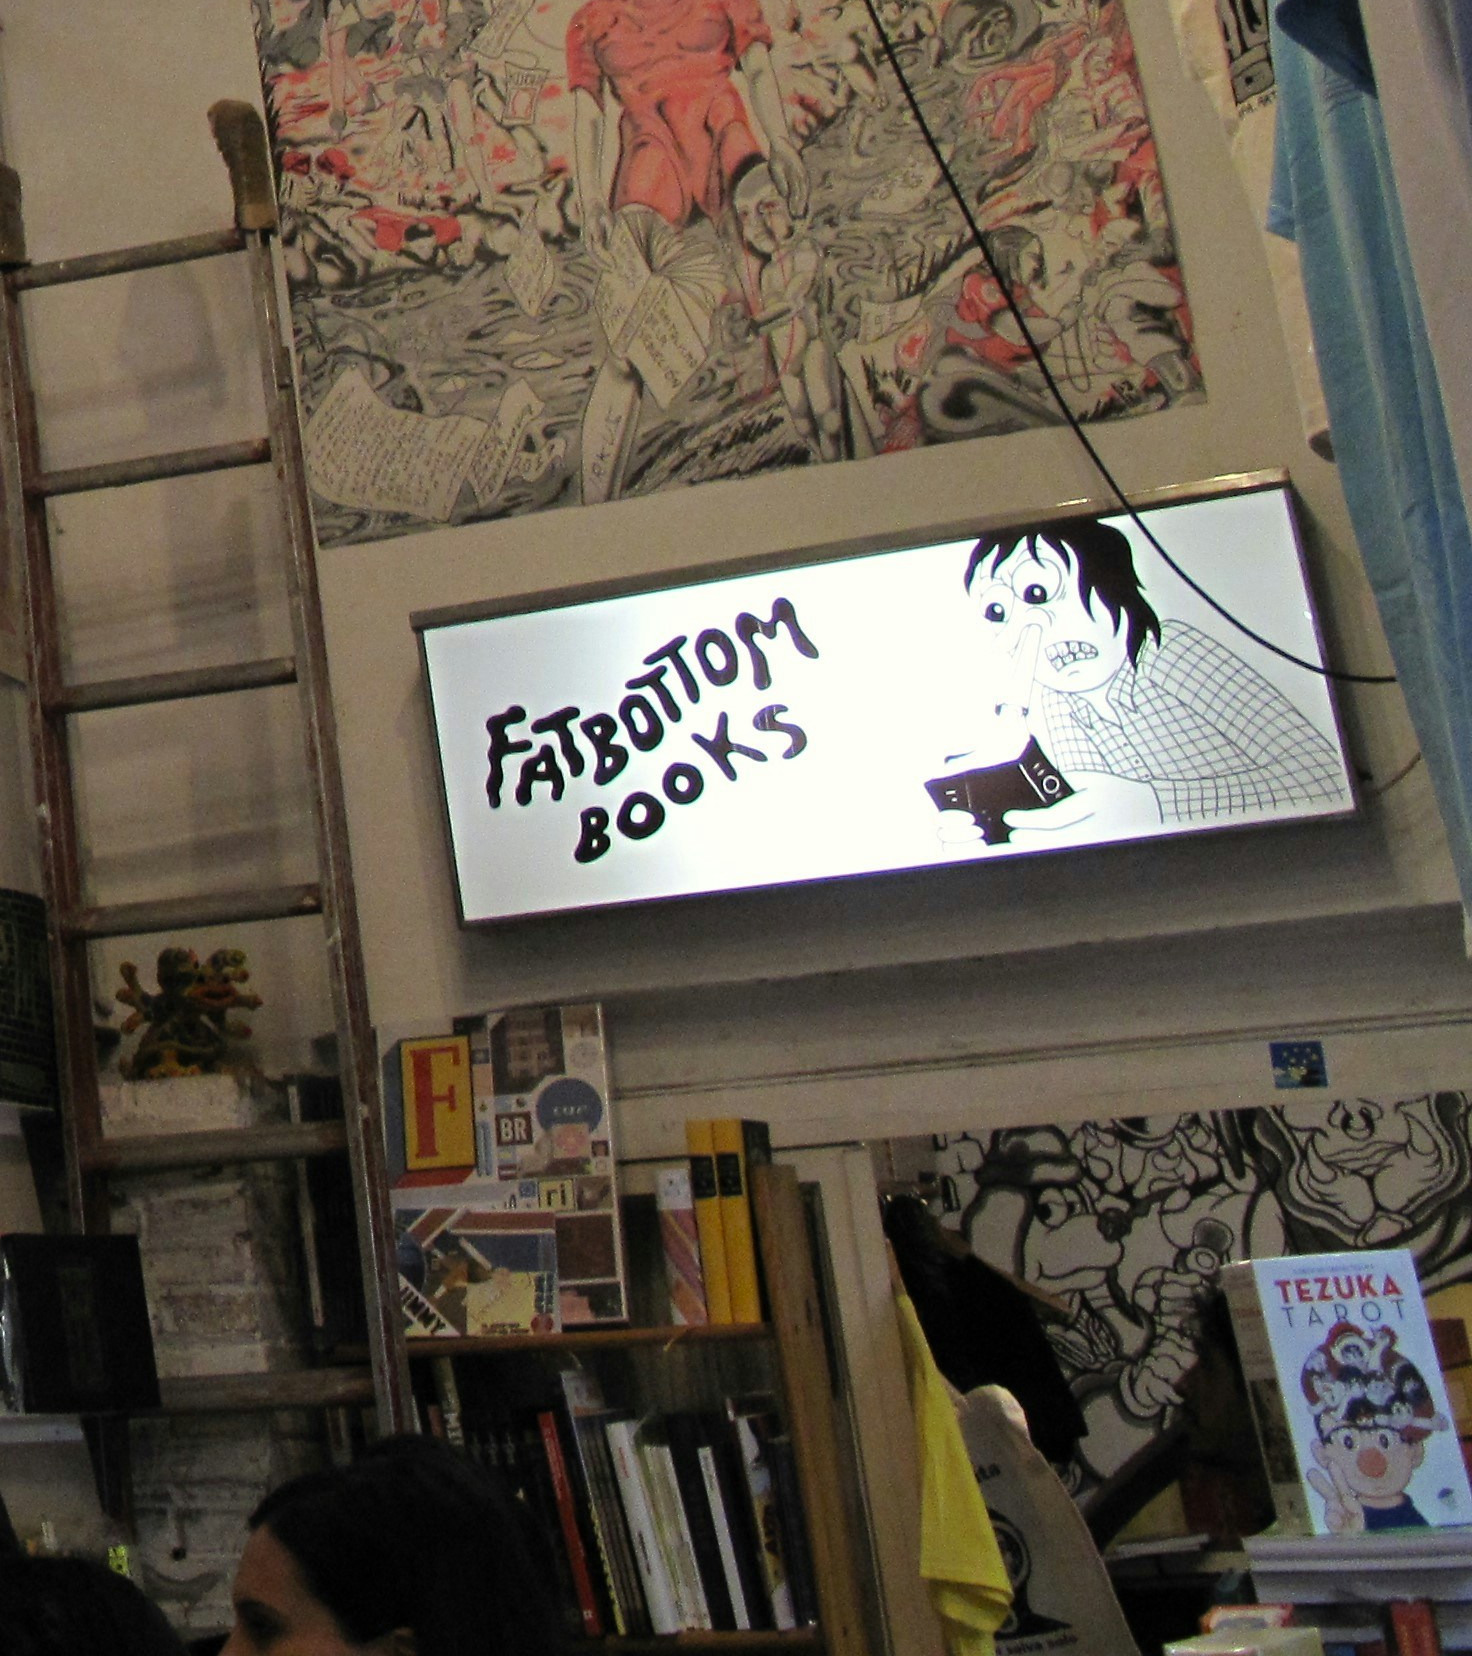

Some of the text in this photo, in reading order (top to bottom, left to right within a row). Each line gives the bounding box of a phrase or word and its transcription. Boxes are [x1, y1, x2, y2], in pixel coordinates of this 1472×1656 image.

[486, 597, 819, 810] FATBOTTOM
[573, 704, 809, 863] BOOKS
[409, 1045, 461, 1159] F
[1274, 1272, 1403, 1304] TEZUKA
[1281, 1297, 1407, 1328] TAROT
